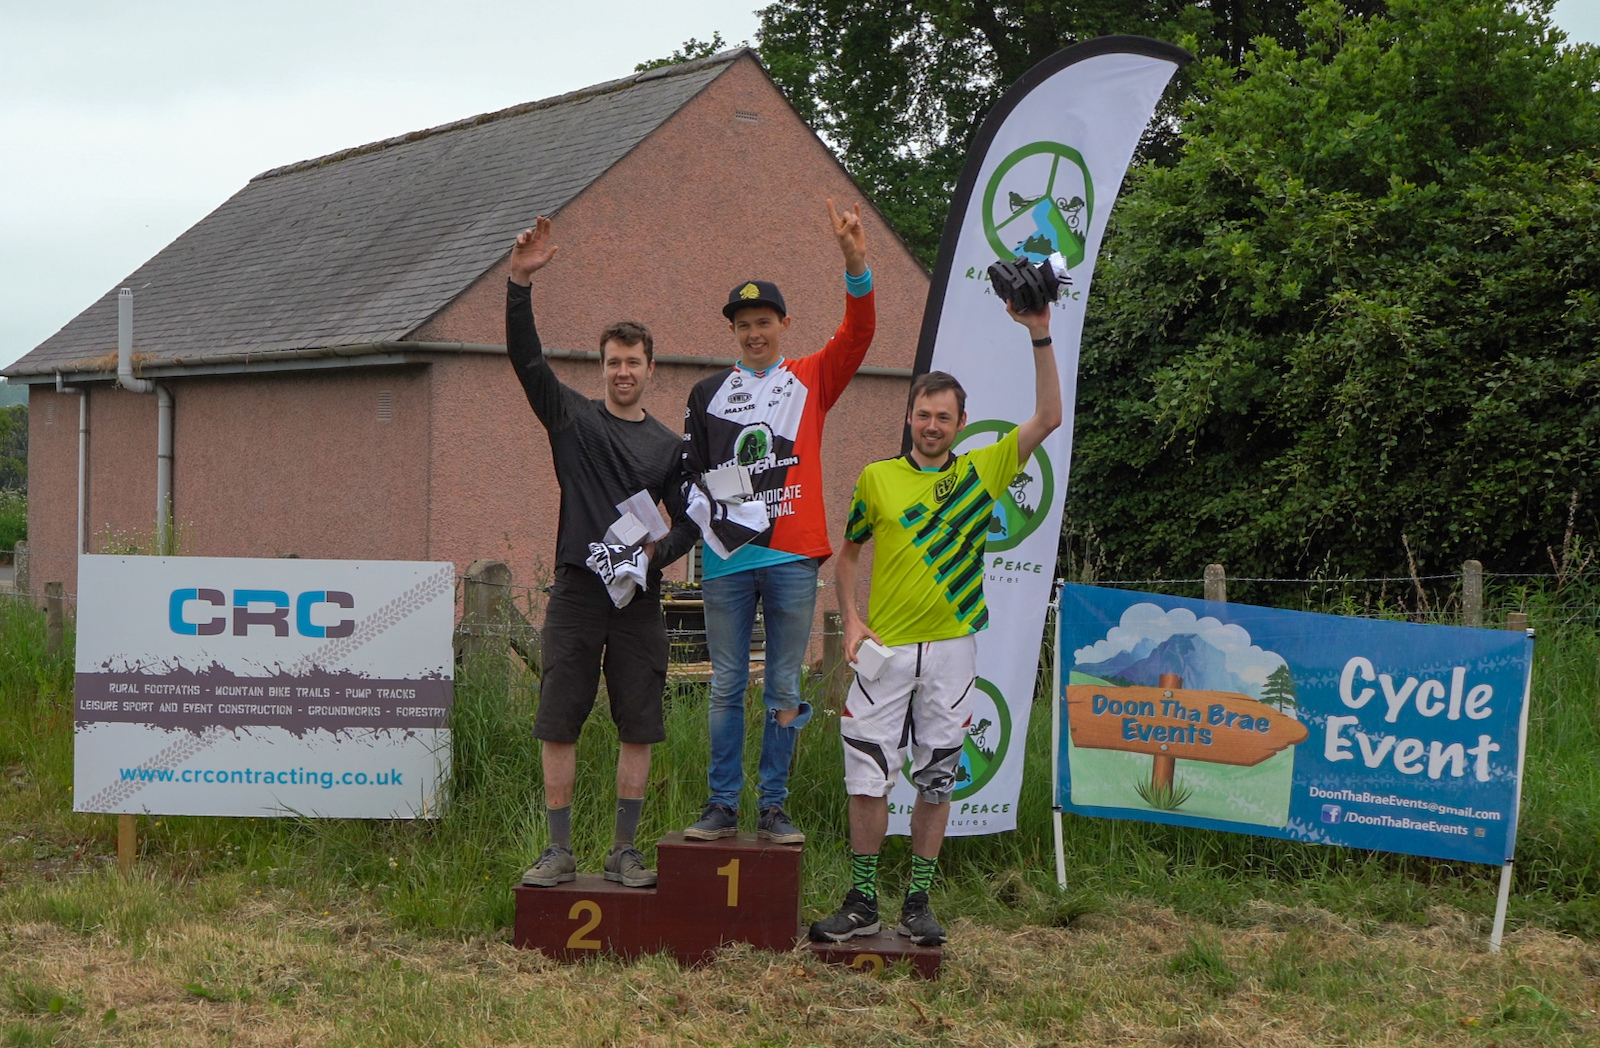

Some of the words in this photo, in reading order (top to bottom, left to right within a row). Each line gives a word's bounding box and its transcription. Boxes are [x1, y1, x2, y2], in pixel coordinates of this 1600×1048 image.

[724, 404, 756, 415] MAXXIS
[992, 557, 1043, 573] PEACE
[169, 588, 355, 639] CRC
[109, 682, 139, 694] RURAL
[144, 684, 201, 696] FOOTPATHS
[215, 686, 264, 697] MOUNTAIN
[268, 686, 291, 697] BIKE
[296, 687, 331, 698] TRAILS
[345, 688, 372, 699] PUMP
[376, 688, 416, 699] TRACKS
[1339, 656, 1493, 724] Cycle
[80, 700, 118, 711] LEISURE
[122, 701, 154, 712] SPORT
[159, 702, 178, 713] AND
[183, 703, 213, 714] EVENT
[218, 703, 293, 715] CONSTRUCTION
[308, 706, 381, 717] GROUNDWORKS
[396, 706, 447, 718] FORESTRY
[1092, 694, 1156, 718] Doon
[1160, 699, 1202, 723] Tha
[1207, 704, 1271, 734] Brae
[1122, 717, 1213, 746] Events
[1324, 715, 1500, 782] Event
[119, 766, 403, 789] www.crcontracting.co.uk
[960, 803, 1010, 815] PEACE
[1309, 786, 1501, 821] DoonThaBraeEvents@gmail.com
[1344, 811, 1469, 836] /DoonThaBraeEvents
[716, 858, 740, 907] 1
[566, 900, 603, 950] 2
